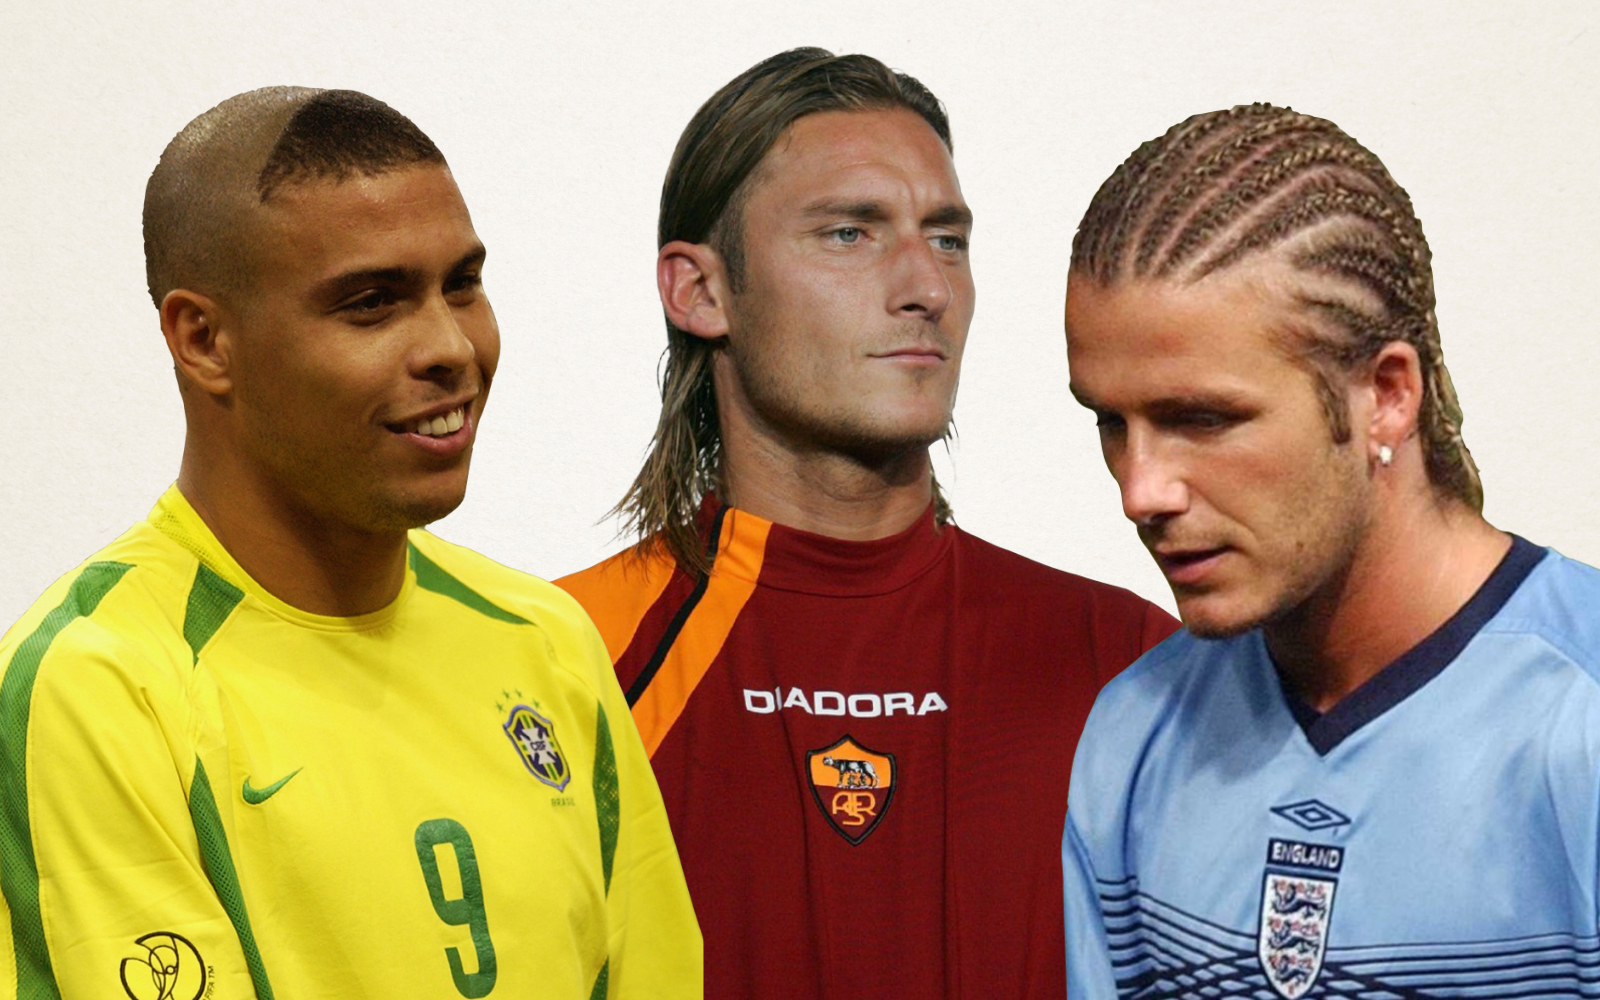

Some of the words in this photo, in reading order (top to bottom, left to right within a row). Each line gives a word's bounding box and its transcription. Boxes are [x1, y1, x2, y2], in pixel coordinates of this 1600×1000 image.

[743, 686, 948, 718] DIADORA
[550, 797, 576, 807] BRASIL
[1271, 841, 1340, 869] ENGLAND
[414, 818, 498, 1000] 9
